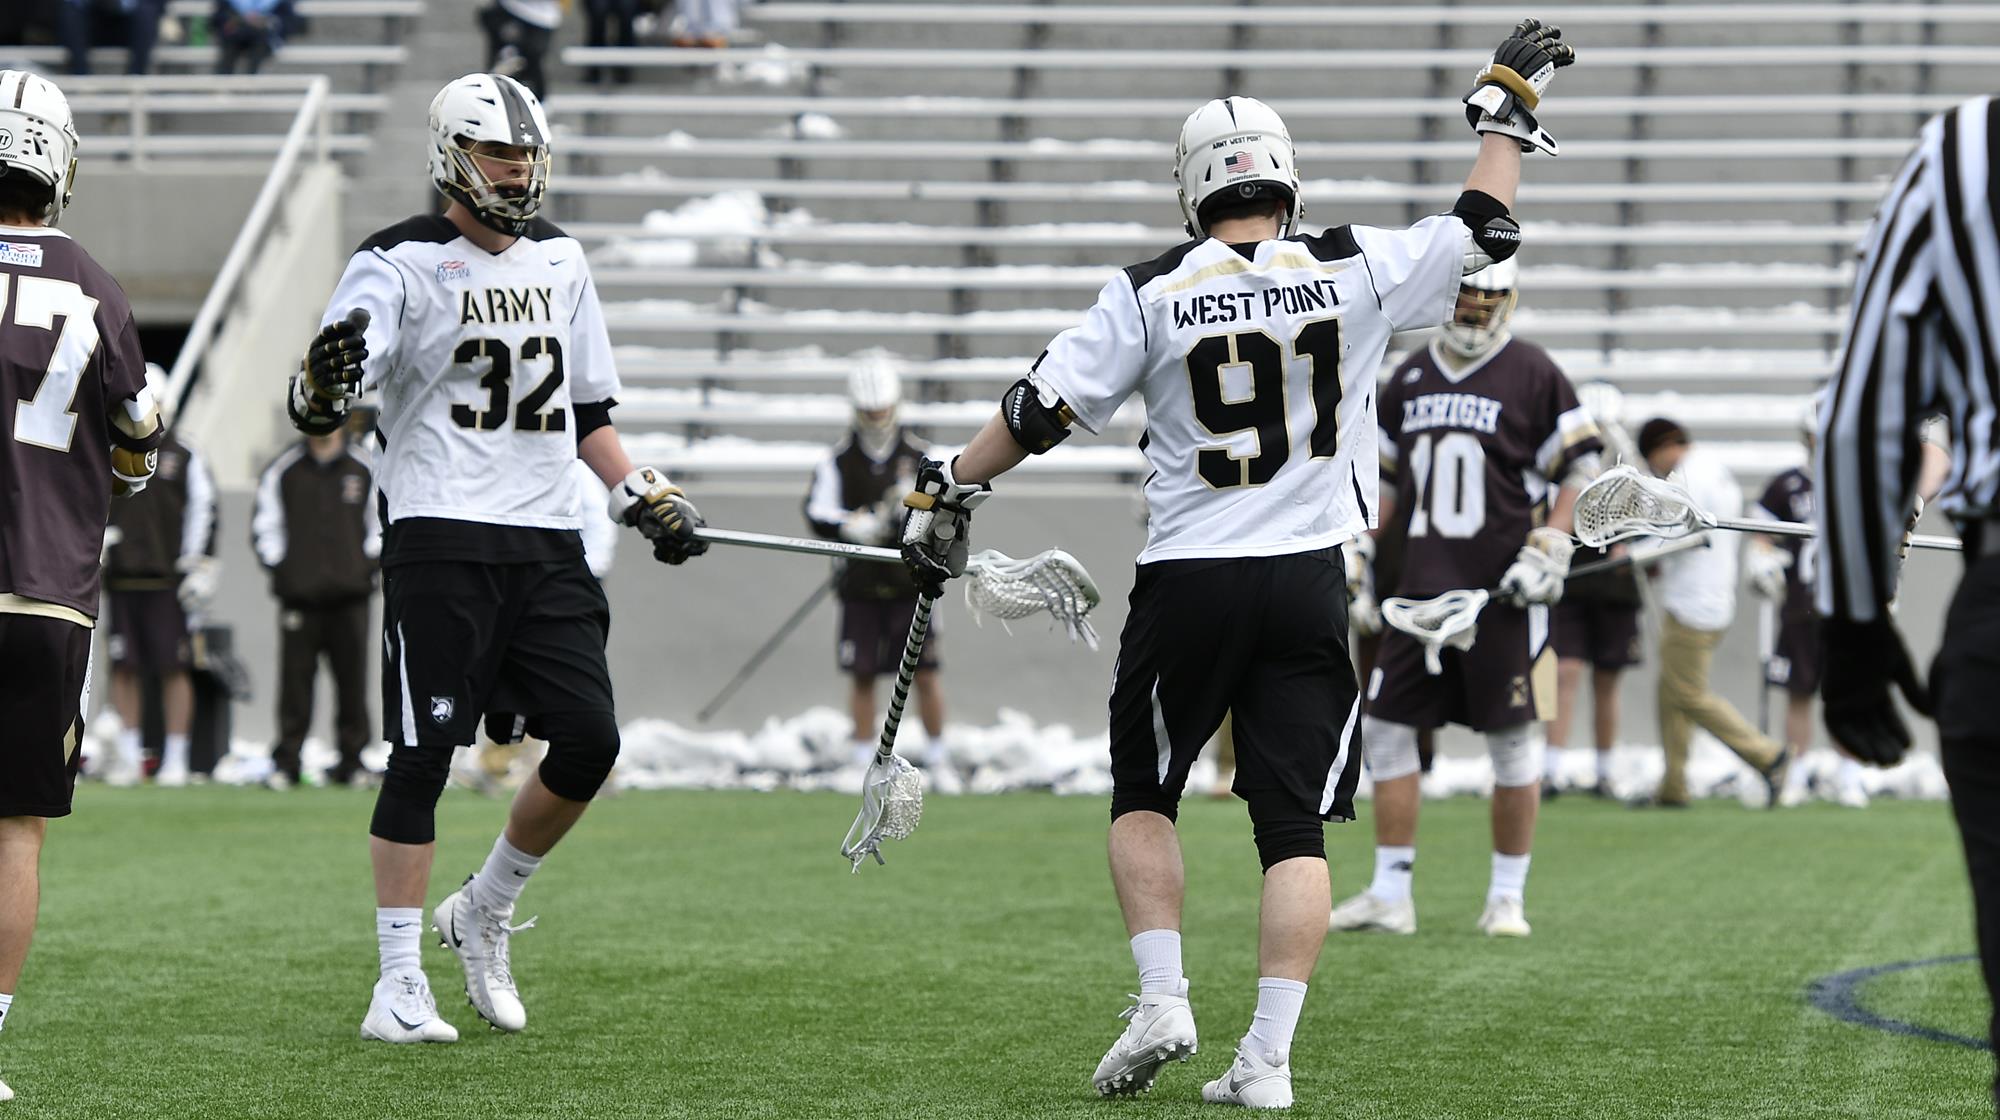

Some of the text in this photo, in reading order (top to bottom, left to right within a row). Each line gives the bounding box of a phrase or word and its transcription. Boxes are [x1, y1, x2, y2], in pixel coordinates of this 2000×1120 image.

[460, 287, 552, 324] ARMY
[1173, 280, 1340, 330] WEST POINT
[0, 272, 100, 453] 7
[450, 335, 567, 432] 32
[1012, 386, 1026, 431] BRINE
[1184, 316, 1344, 492] 91
[1400, 392, 1503, 434] LEHIGH
[1409, 433, 1486, 538] 10
